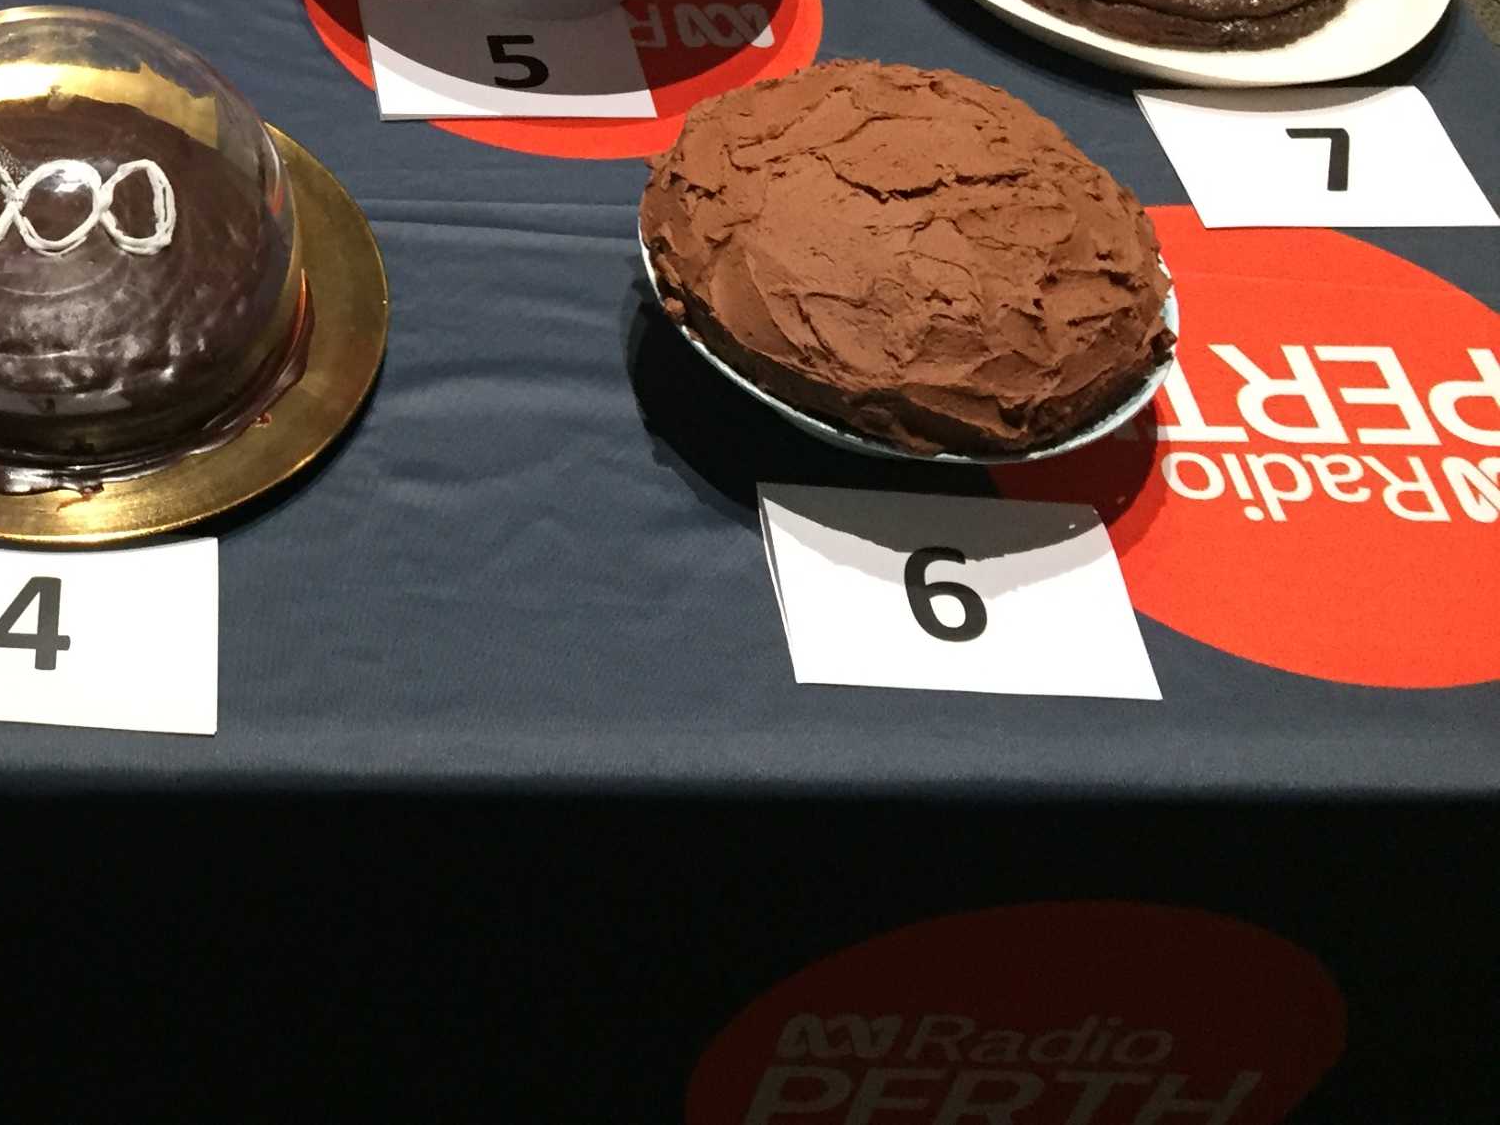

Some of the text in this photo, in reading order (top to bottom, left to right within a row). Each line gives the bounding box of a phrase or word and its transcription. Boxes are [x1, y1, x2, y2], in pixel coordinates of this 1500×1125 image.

[486, 34, 549, 89] 5
[1285, 127, 1350, 192] 7
[1160, 451, 1452, 523] Radio
[903, 546, 988, 643] 6
[897, 1014, 1174, 1065] Radio
